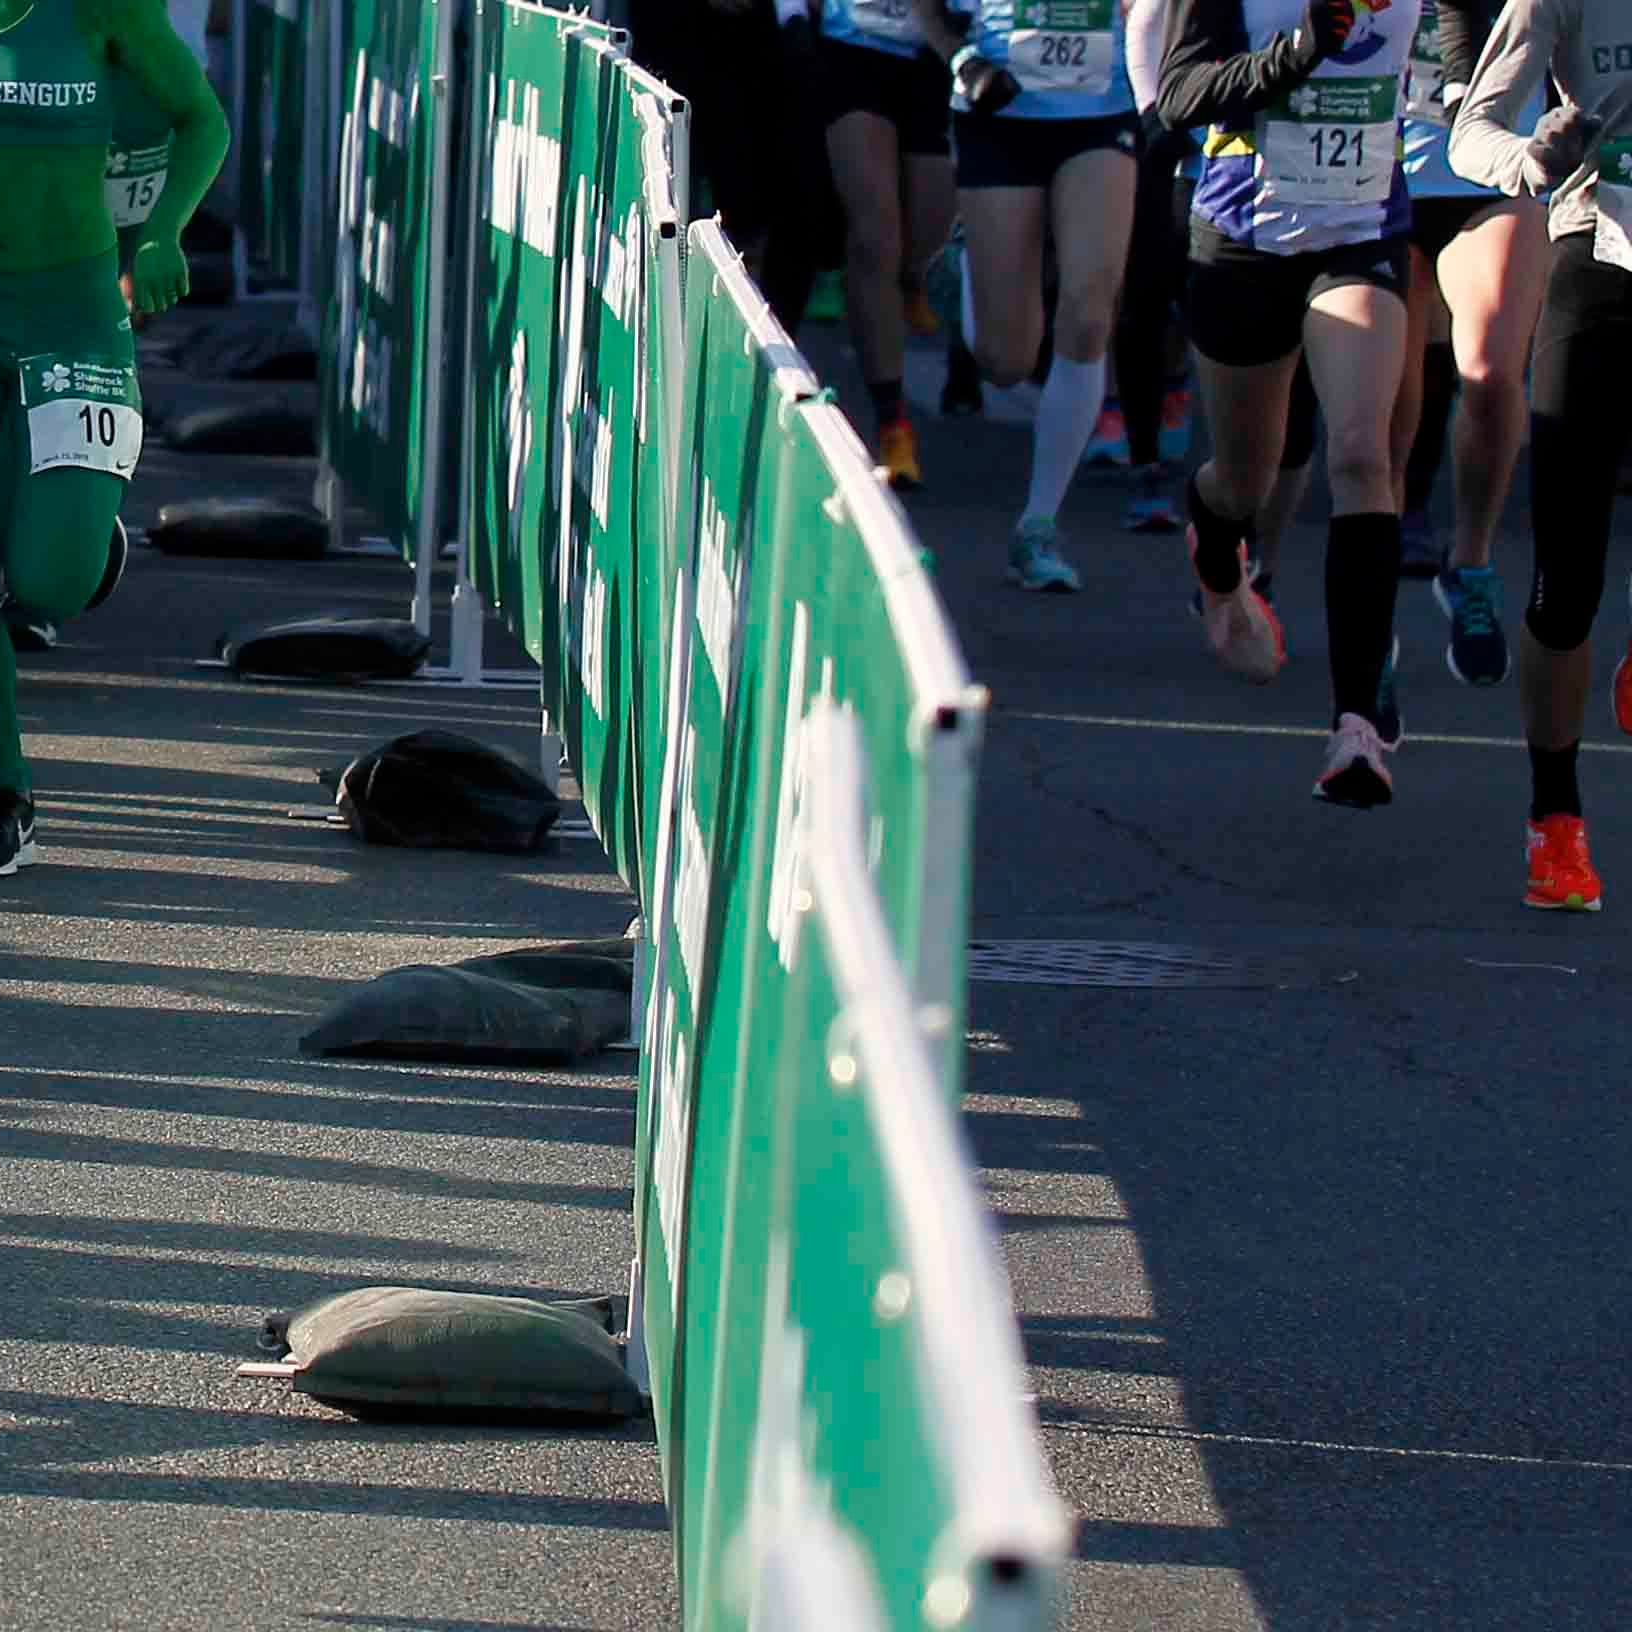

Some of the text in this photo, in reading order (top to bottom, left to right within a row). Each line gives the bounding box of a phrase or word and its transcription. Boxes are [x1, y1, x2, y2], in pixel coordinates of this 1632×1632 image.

[1039, 35, 1087, 67] 262
[1309, 128, 1363, 167] 121
[126, 176, 154, 209] 15
[79, 404, 116, 447] 10
